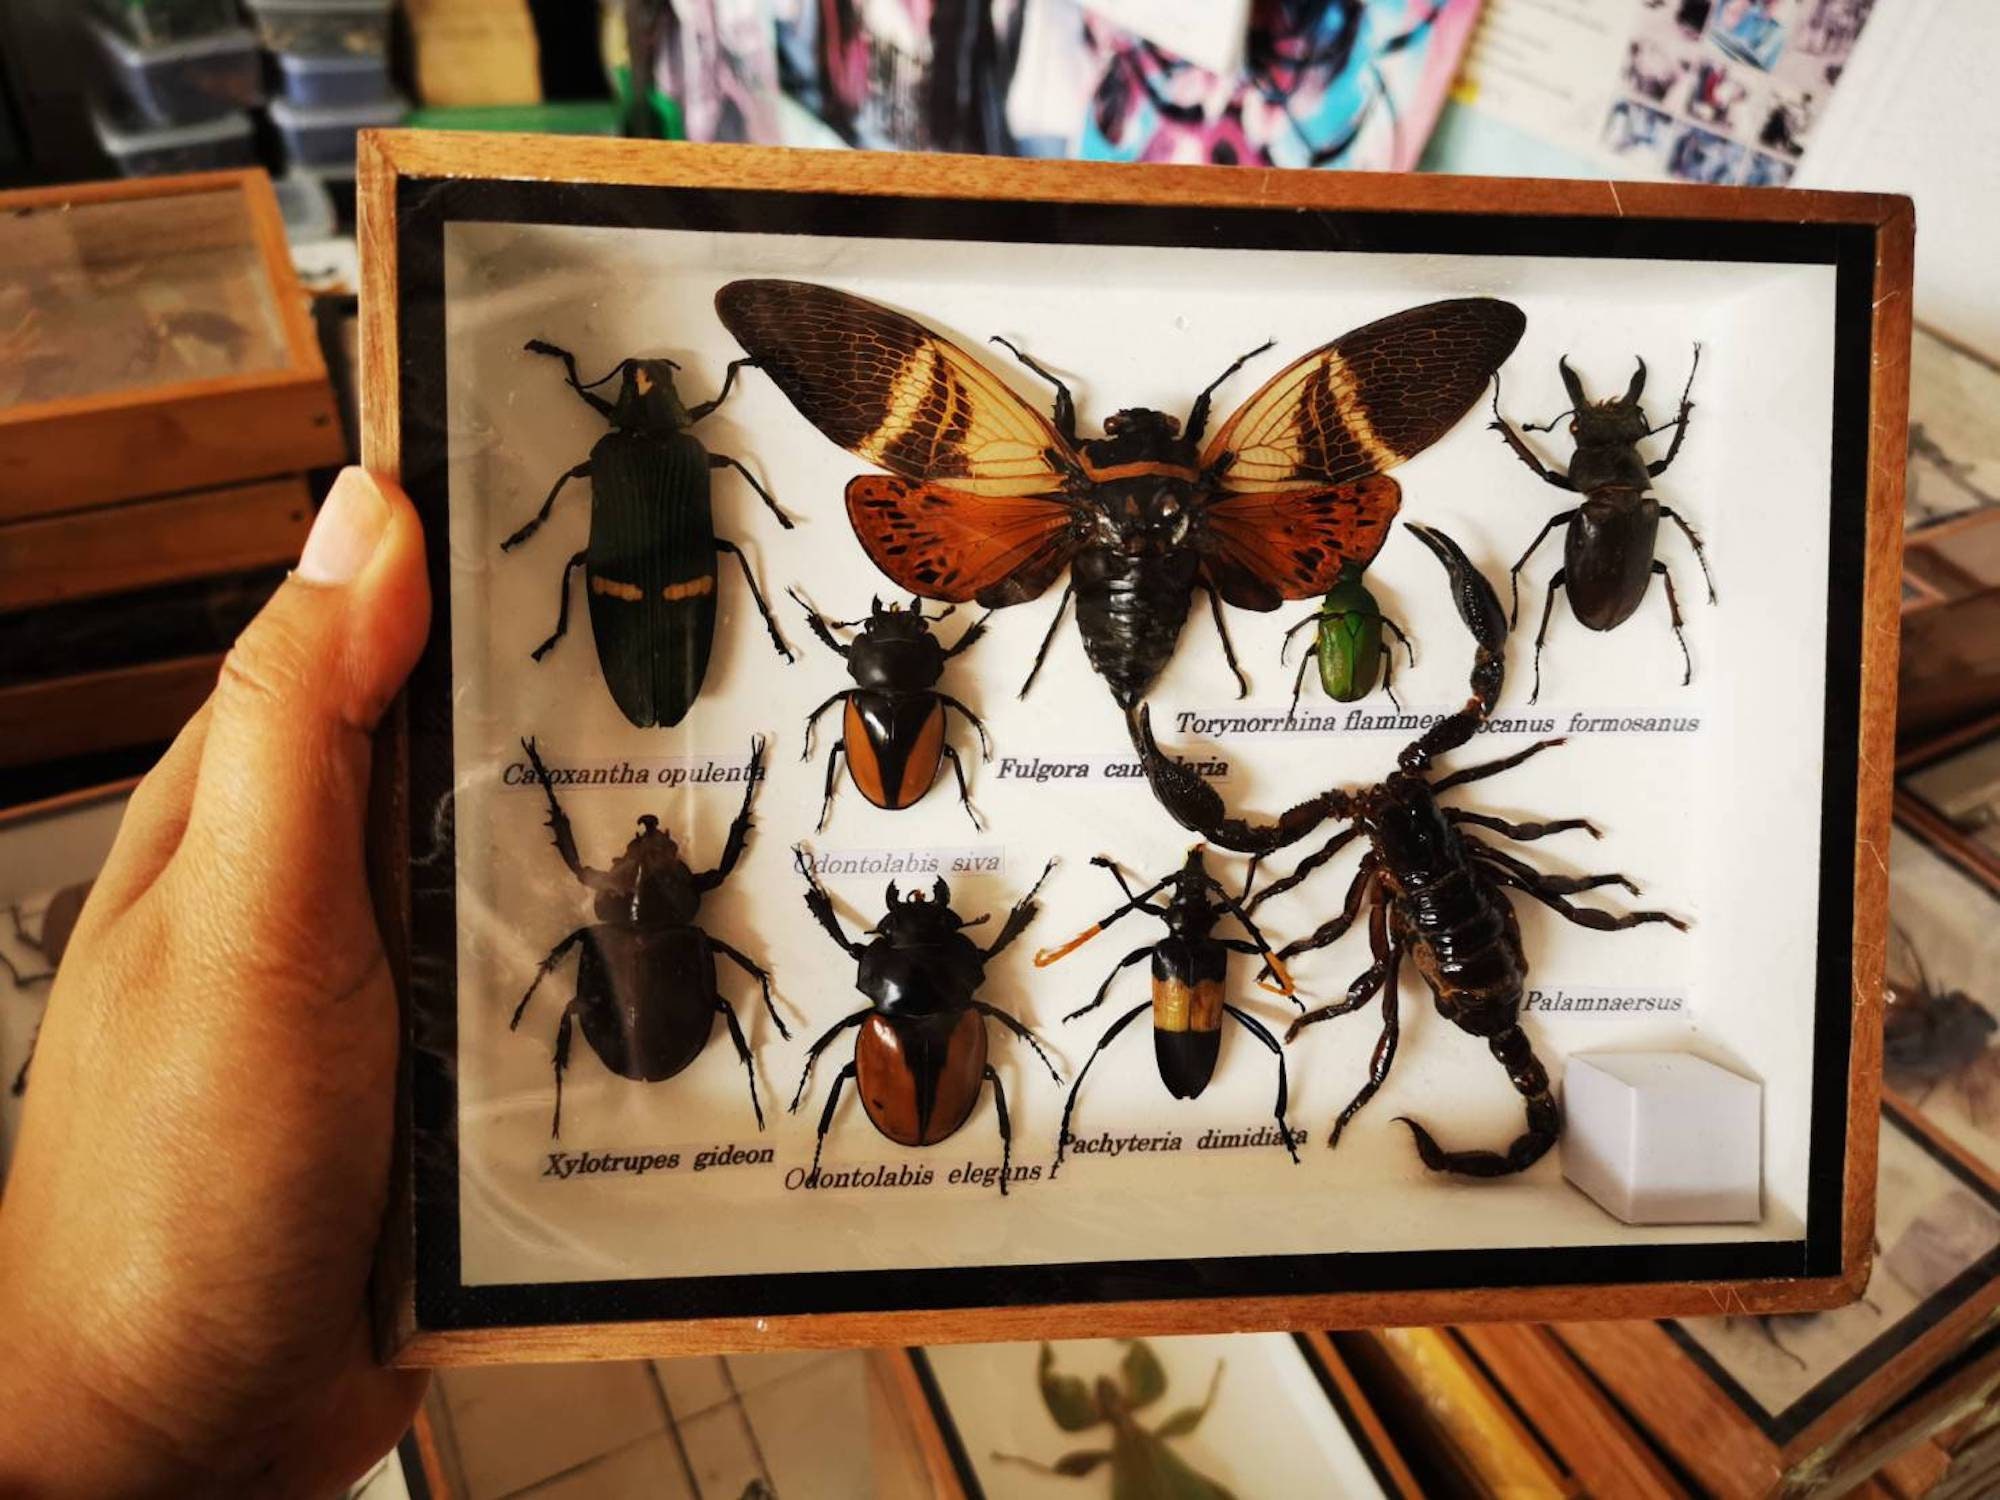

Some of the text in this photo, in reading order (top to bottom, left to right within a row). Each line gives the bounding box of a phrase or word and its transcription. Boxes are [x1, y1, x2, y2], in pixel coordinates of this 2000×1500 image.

[1176, 711, 1336, 737] Torynorrhina
[1567, 712, 1700, 733] formosanus
[657, 762, 767, 787] opulenta
[997, 757, 1089, 783] Fulgora
[794, 851, 1000, 875] Odontolabis siva
[1521, 990, 1683, 1012] Palamnaersus
[542, 1145, 775, 1179] Xylotrupes gideon
[785, 1163, 934, 1190] Odontolabis
